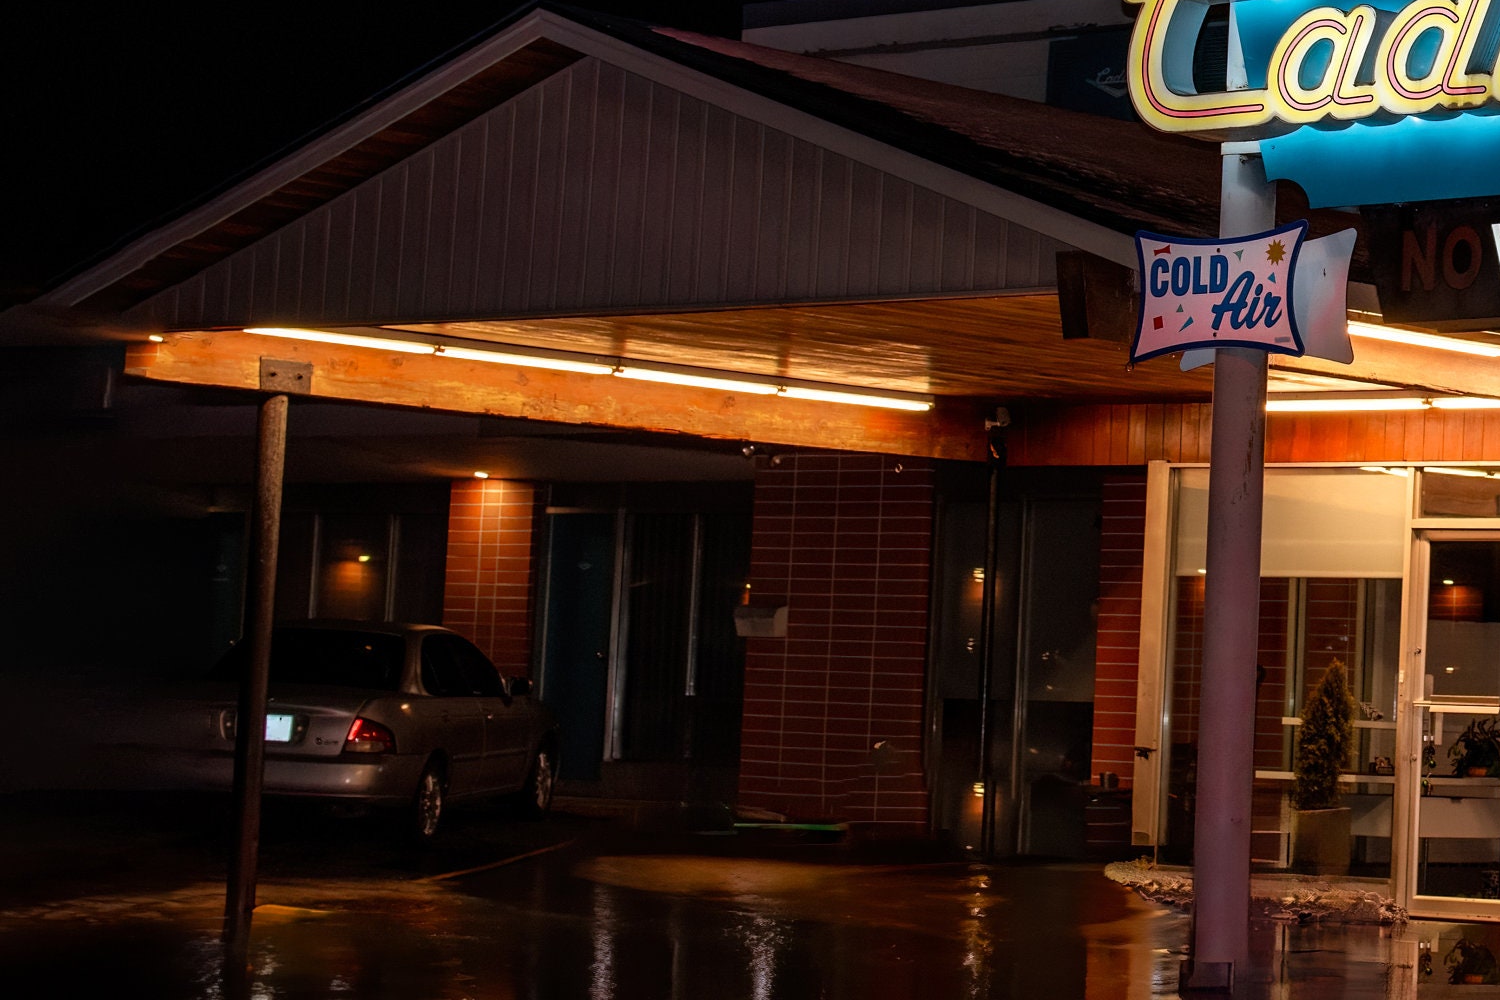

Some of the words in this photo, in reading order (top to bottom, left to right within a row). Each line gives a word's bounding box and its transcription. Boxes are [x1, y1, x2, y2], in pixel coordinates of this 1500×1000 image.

[1150, 254, 1229, 298] COLD
[1401, 223, 1483, 292] NO
[1211, 270, 1283, 330] Air
